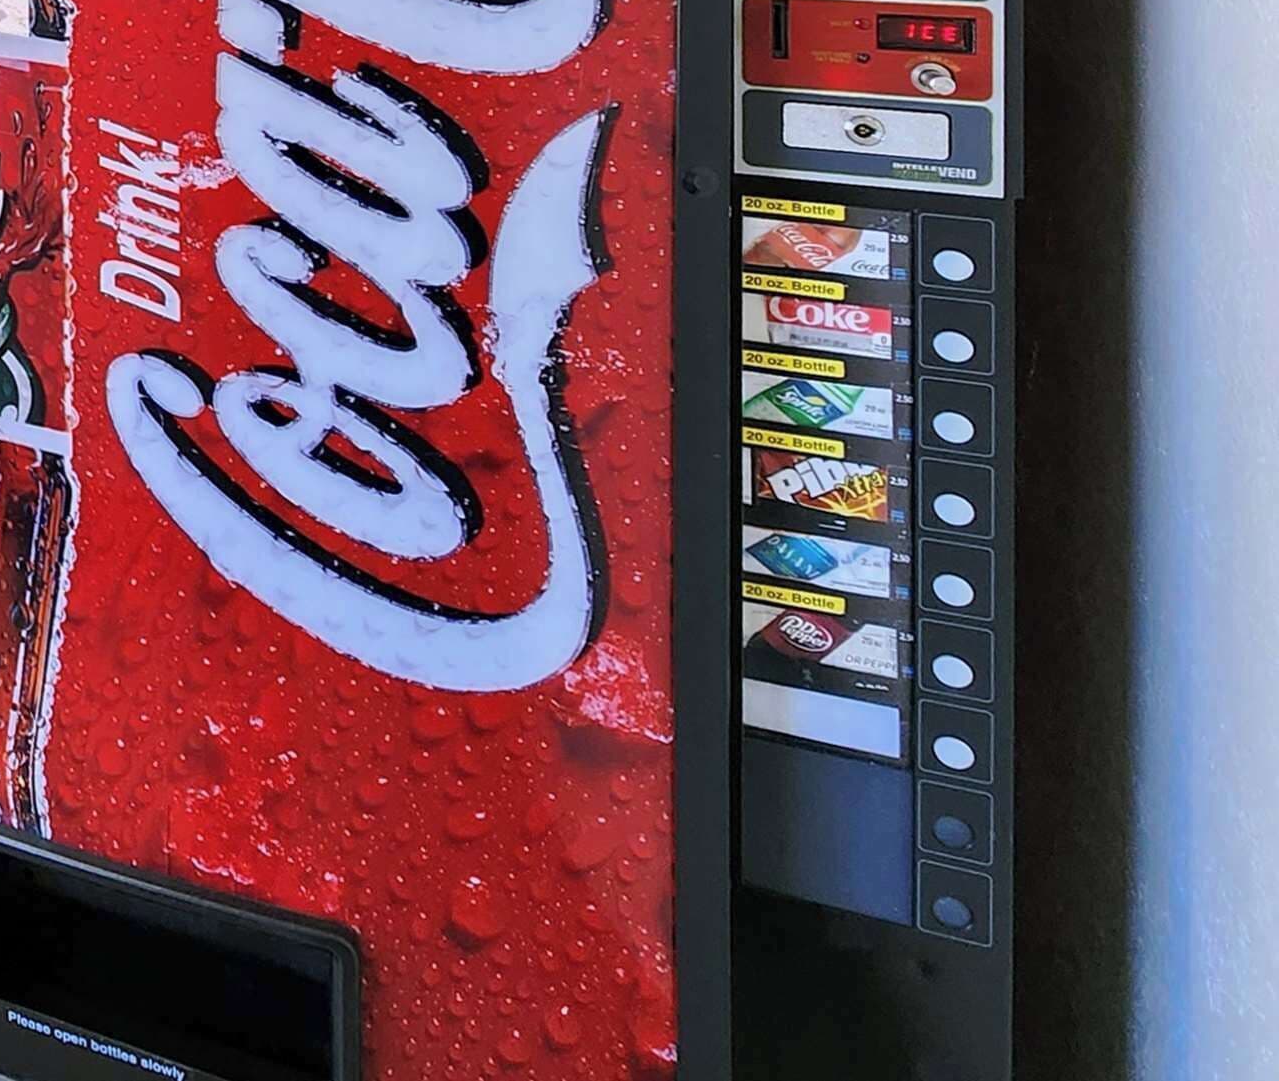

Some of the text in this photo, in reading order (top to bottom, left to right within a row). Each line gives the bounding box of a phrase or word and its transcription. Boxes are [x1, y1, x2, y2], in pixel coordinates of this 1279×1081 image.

[892, 162, 977, 180] INTELLEVEND
[745, 198, 835, 217] 20 oz. Bottle
[98, 118, 181, 322] Drink!
[890, 233, 909, 243] 2.50
[745, 275, 836, 296] 20 oz. Bottle
[769, 296, 871, 333] Coke
[745, 352, 836, 374] 20 oz. Bottle
[895, 394, 914, 404] 2.50
[745, 430, 836, 454] 20 oz. Bottle
[835, 471, 885, 502] Xtra
[767, 534, 821, 580] DASANI
[892, 552, 912, 564] 2.50
[745, 584, 835, 610] 20 oz. Bottle
[780, 616, 829, 648] Pepper
[802, 621, 824, 637] Dr
[845, 655, 862, 664] DR
[8, 1009, 186, 1081] Please open bottles slowly
